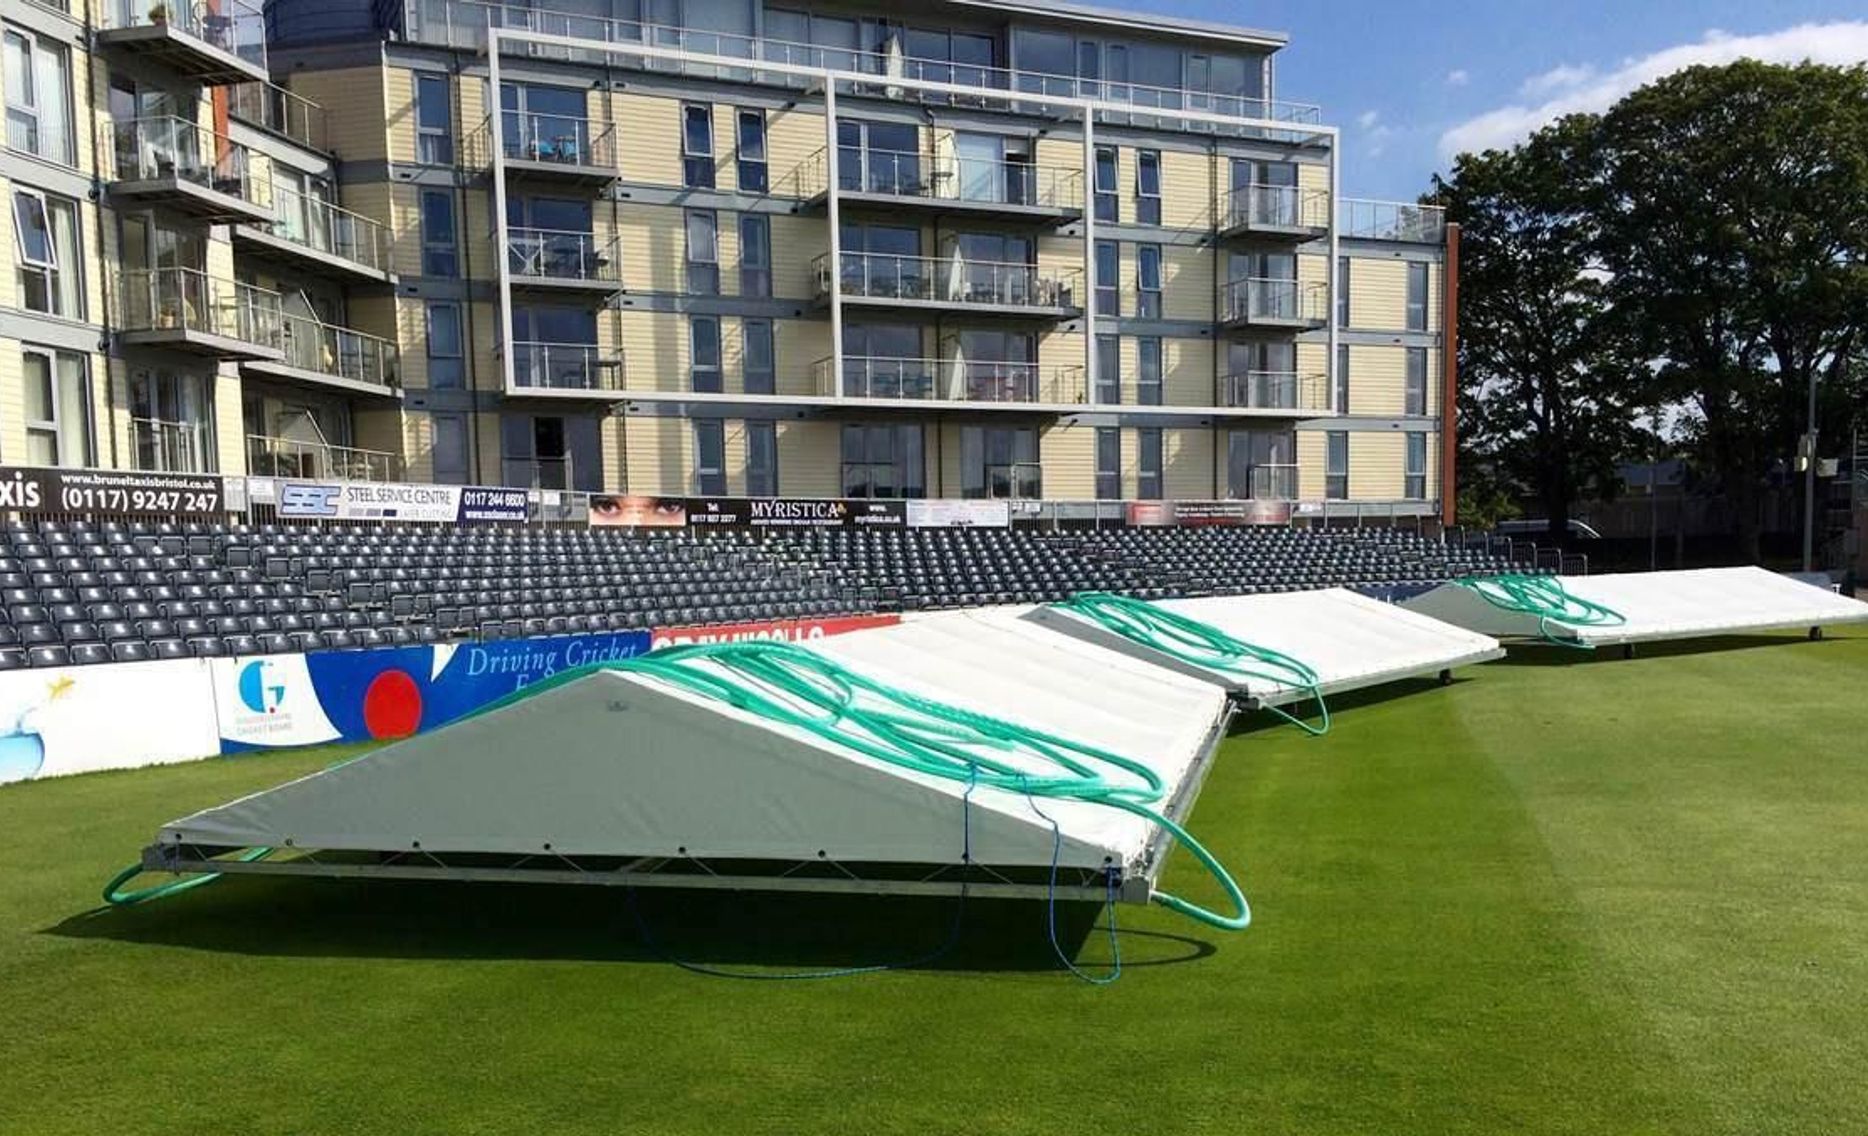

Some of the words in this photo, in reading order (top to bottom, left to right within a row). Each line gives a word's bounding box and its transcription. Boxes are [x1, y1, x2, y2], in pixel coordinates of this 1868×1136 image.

[0, 471, 40, 507] xis
[61, 474, 216, 490] www.bruneltaxisbristol.co.uk
[62, 487, 128, 512] (0117)
[132, 490, 180, 510] 9247
[184, 492, 218, 512] 247
[347, 486, 376, 502] STEEL
[377, 488, 413, 504] SERVICE
[415, 489, 452, 505] CENTRE
[464, 491, 487, 506] 0117
[488, 492, 504, 507] 244
[750, 499, 839, 518] MYRISTICA
[467, 647, 558, 678] Driving
[566, 637, 636, 667] Cricket
